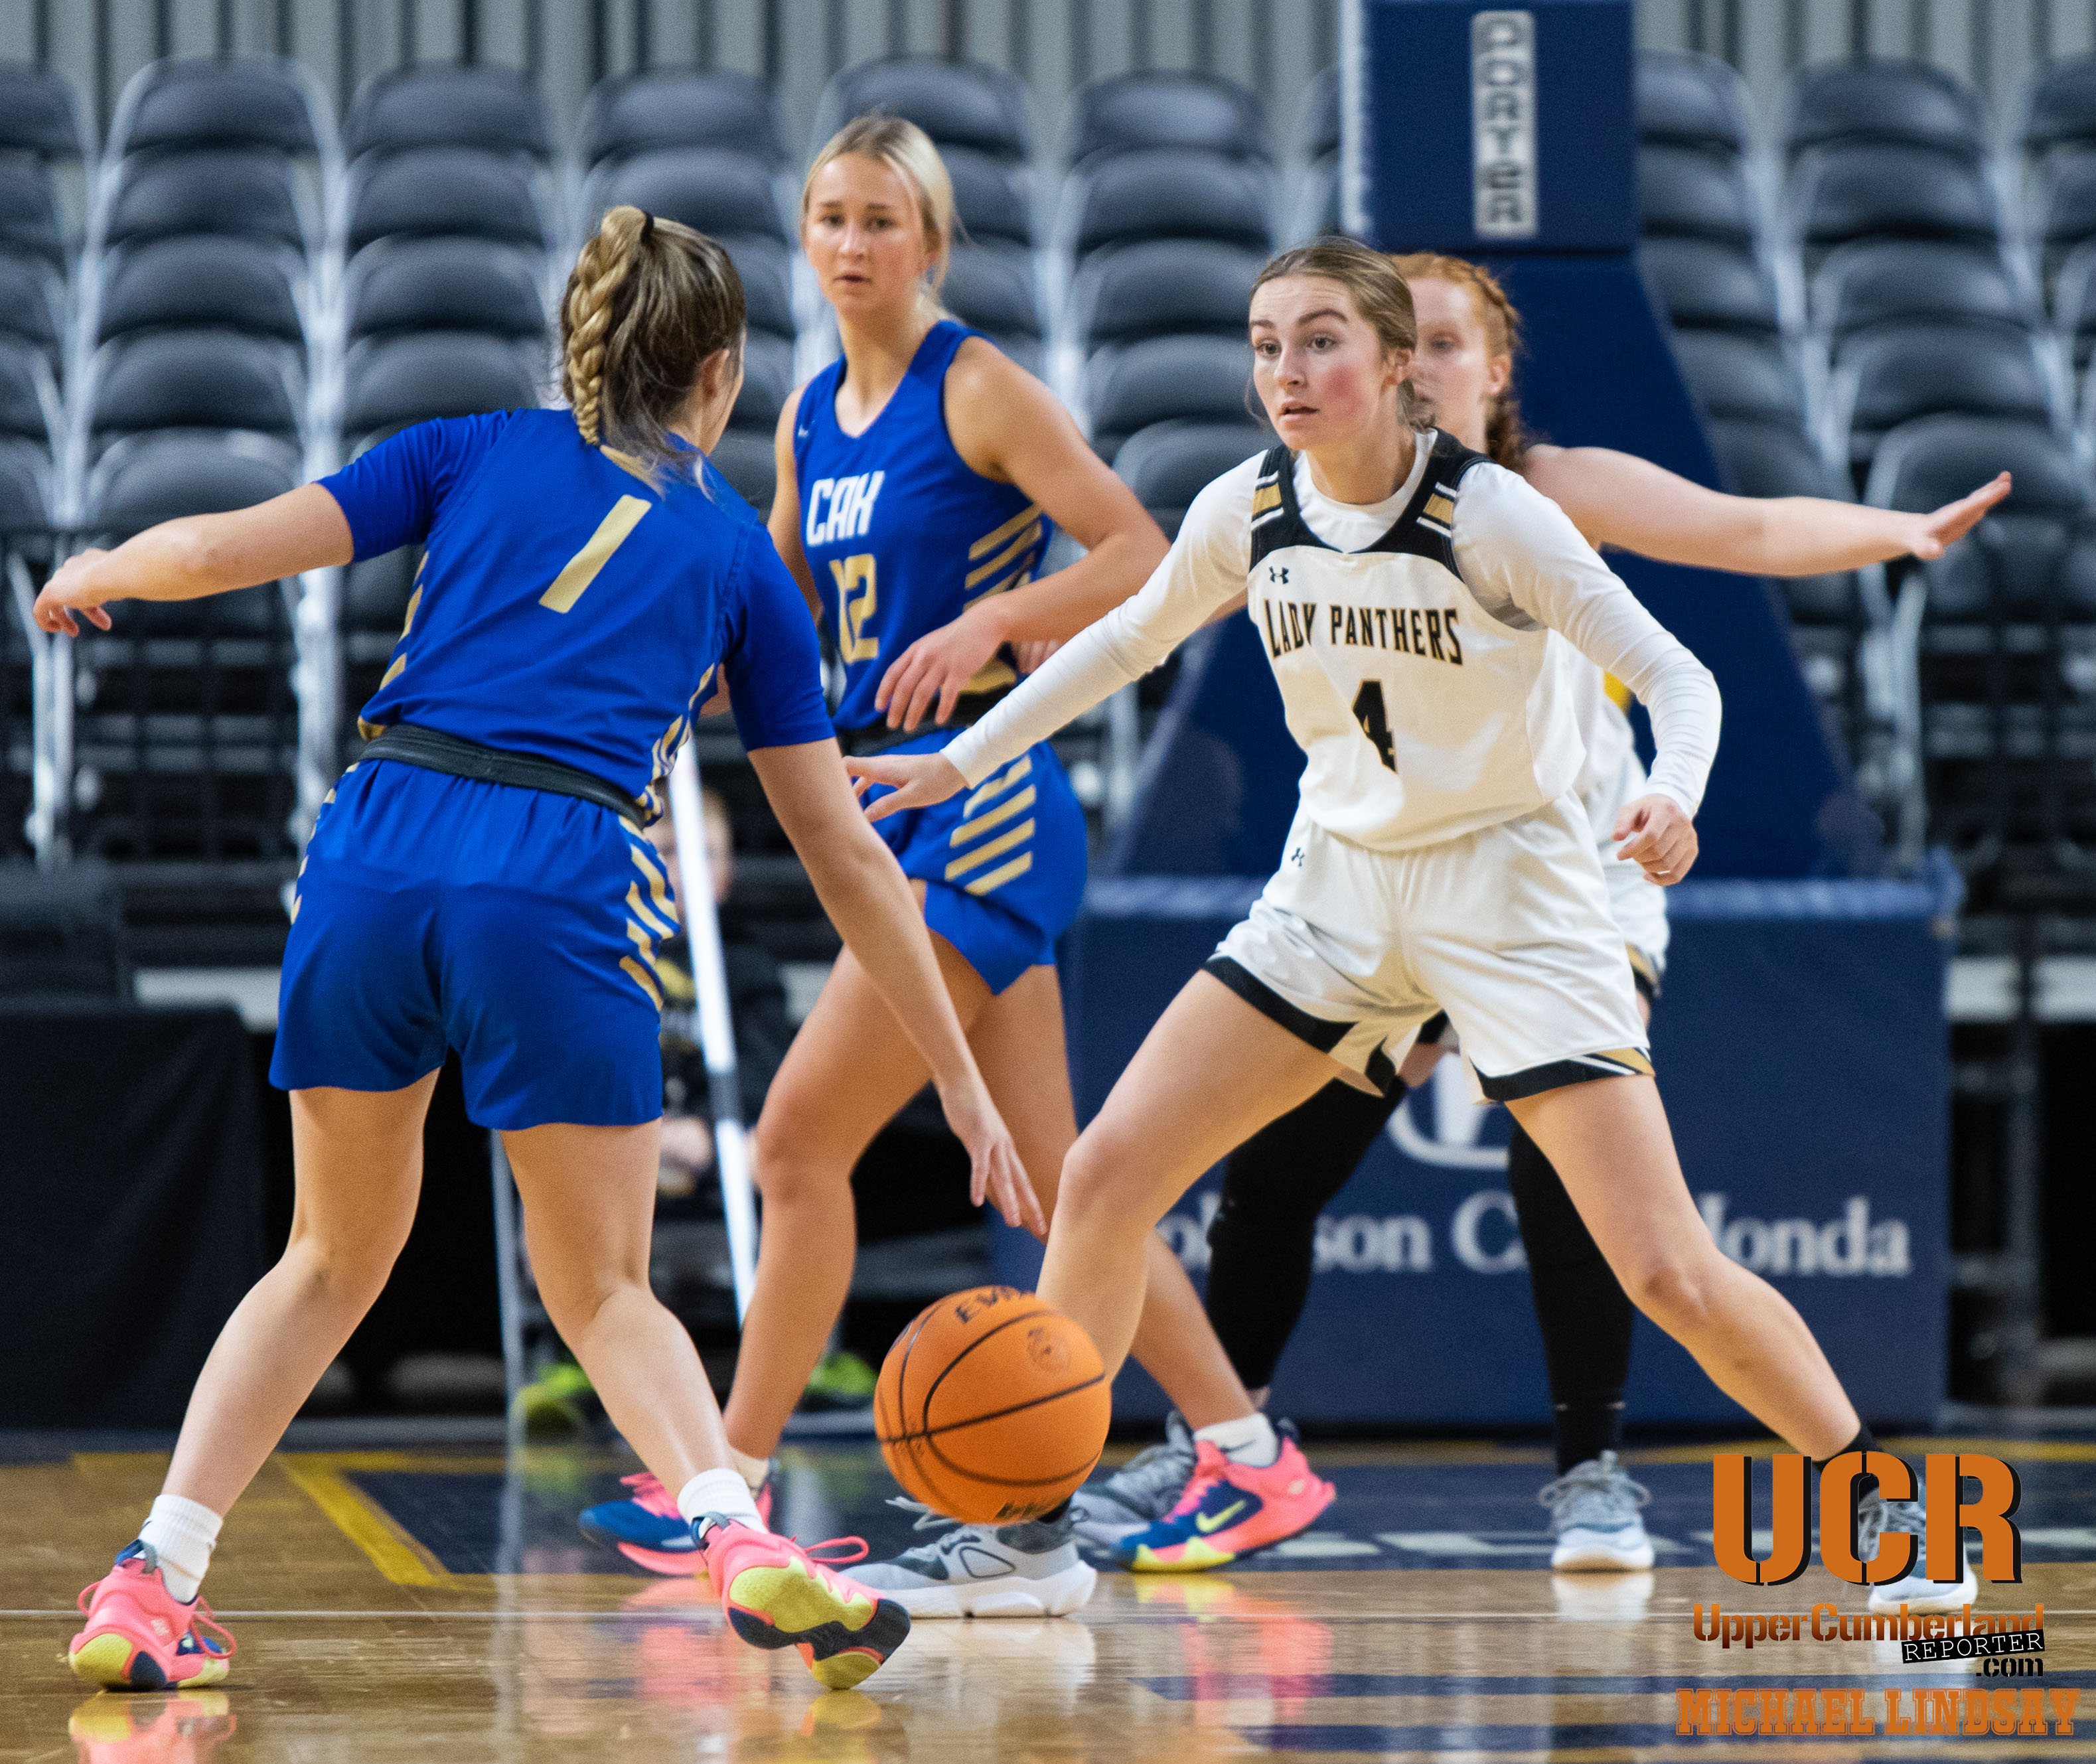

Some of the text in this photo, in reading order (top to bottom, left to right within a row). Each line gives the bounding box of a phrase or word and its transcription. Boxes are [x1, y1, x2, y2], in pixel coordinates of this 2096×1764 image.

[538, 494, 652, 614] 1
[806, 470, 885, 547] CAK
[828, 552, 879, 666] 12
[1263, 599, 1464, 666] LADY PANTHERS
[1351, 678, 1398, 775] 4
